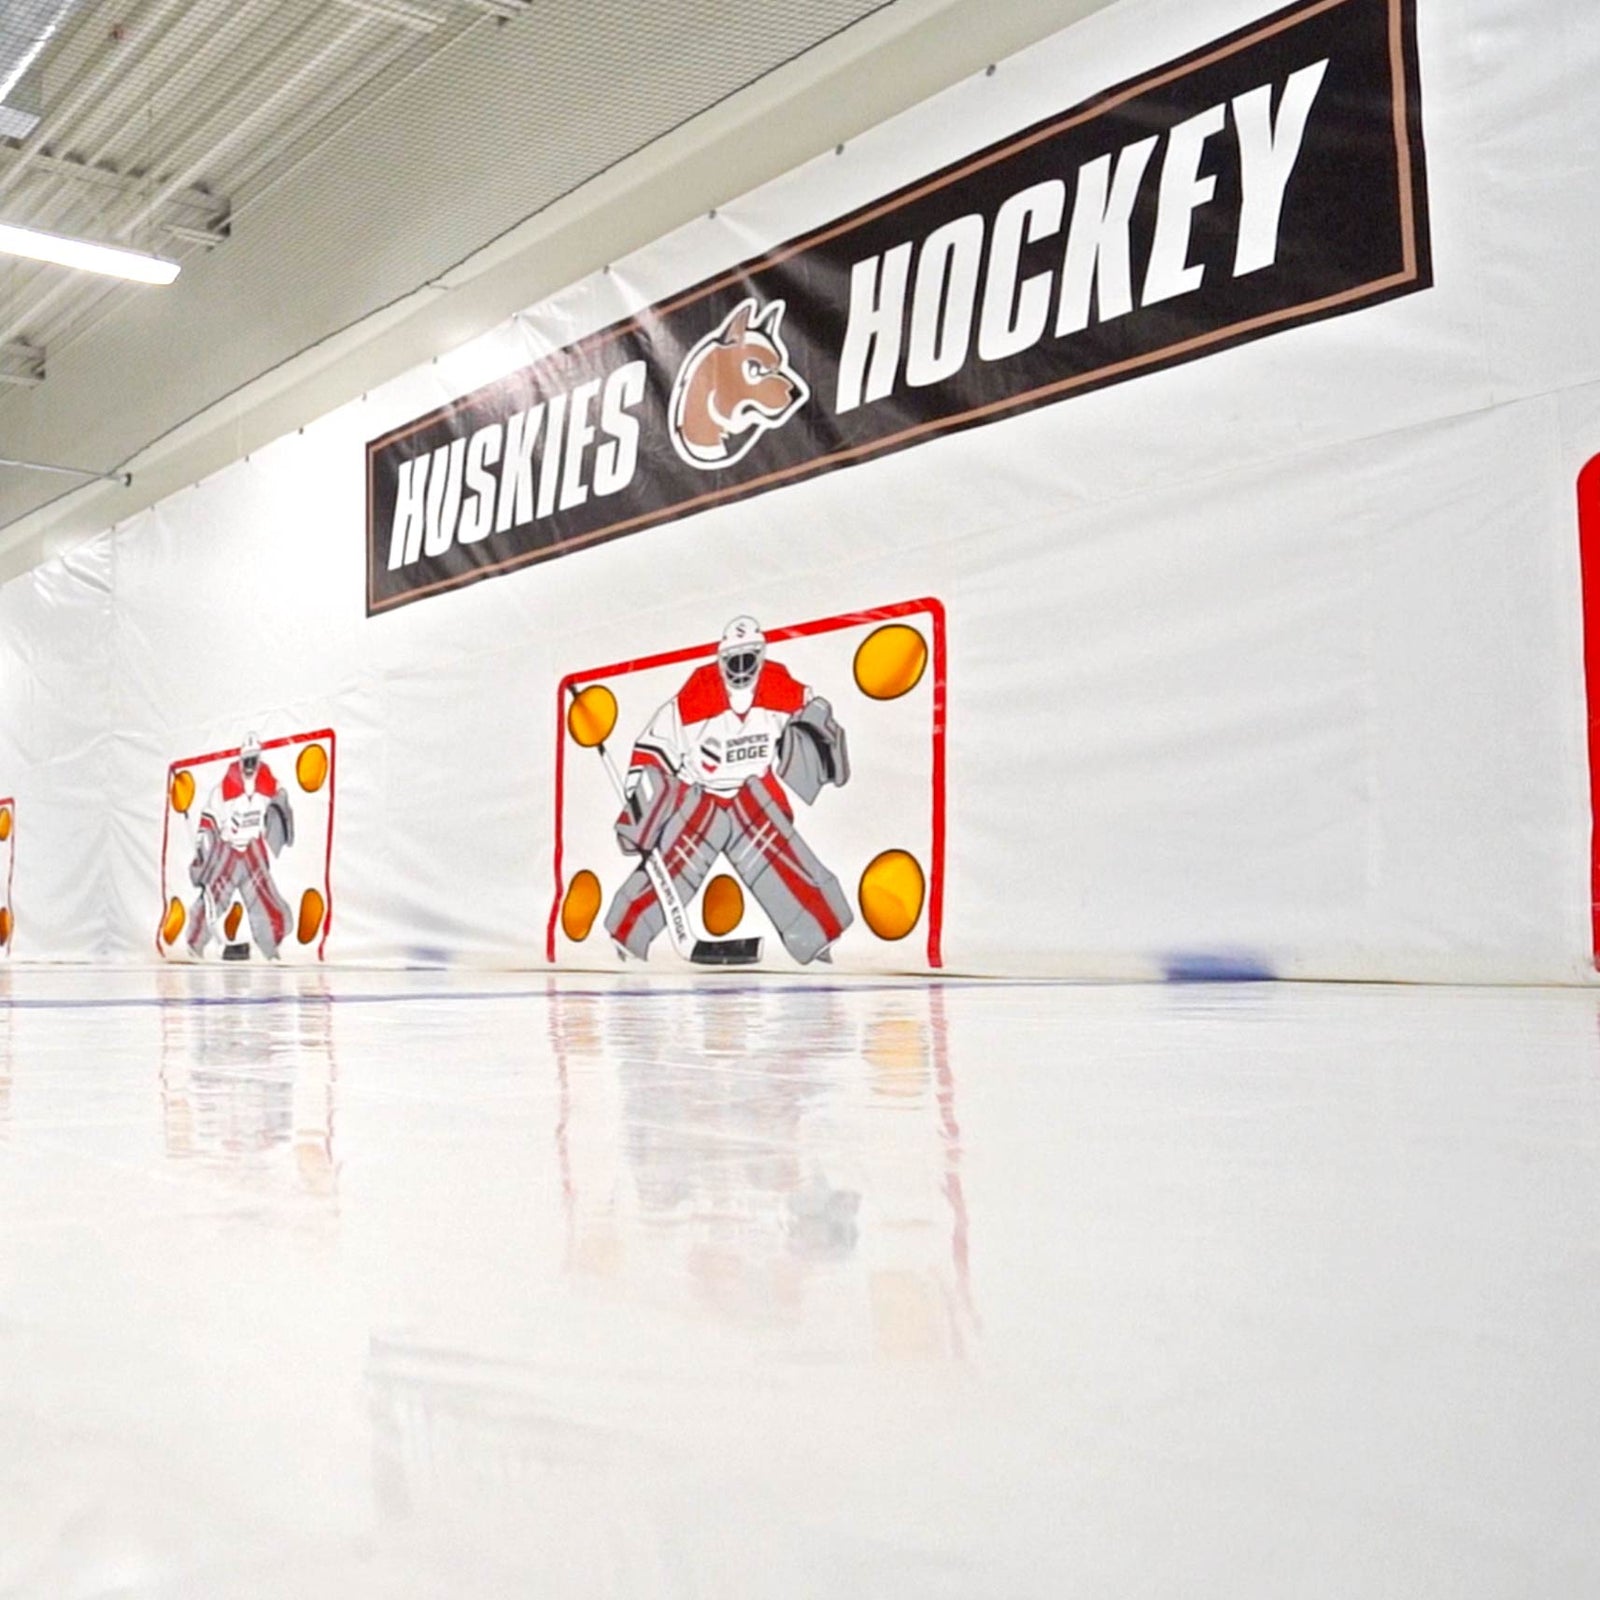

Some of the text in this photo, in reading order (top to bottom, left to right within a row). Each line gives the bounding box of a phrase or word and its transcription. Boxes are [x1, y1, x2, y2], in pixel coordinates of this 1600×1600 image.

[388, 58, 1329, 571] HUSKIES HOCKEY
[726, 745, 769, 763] EDGE
